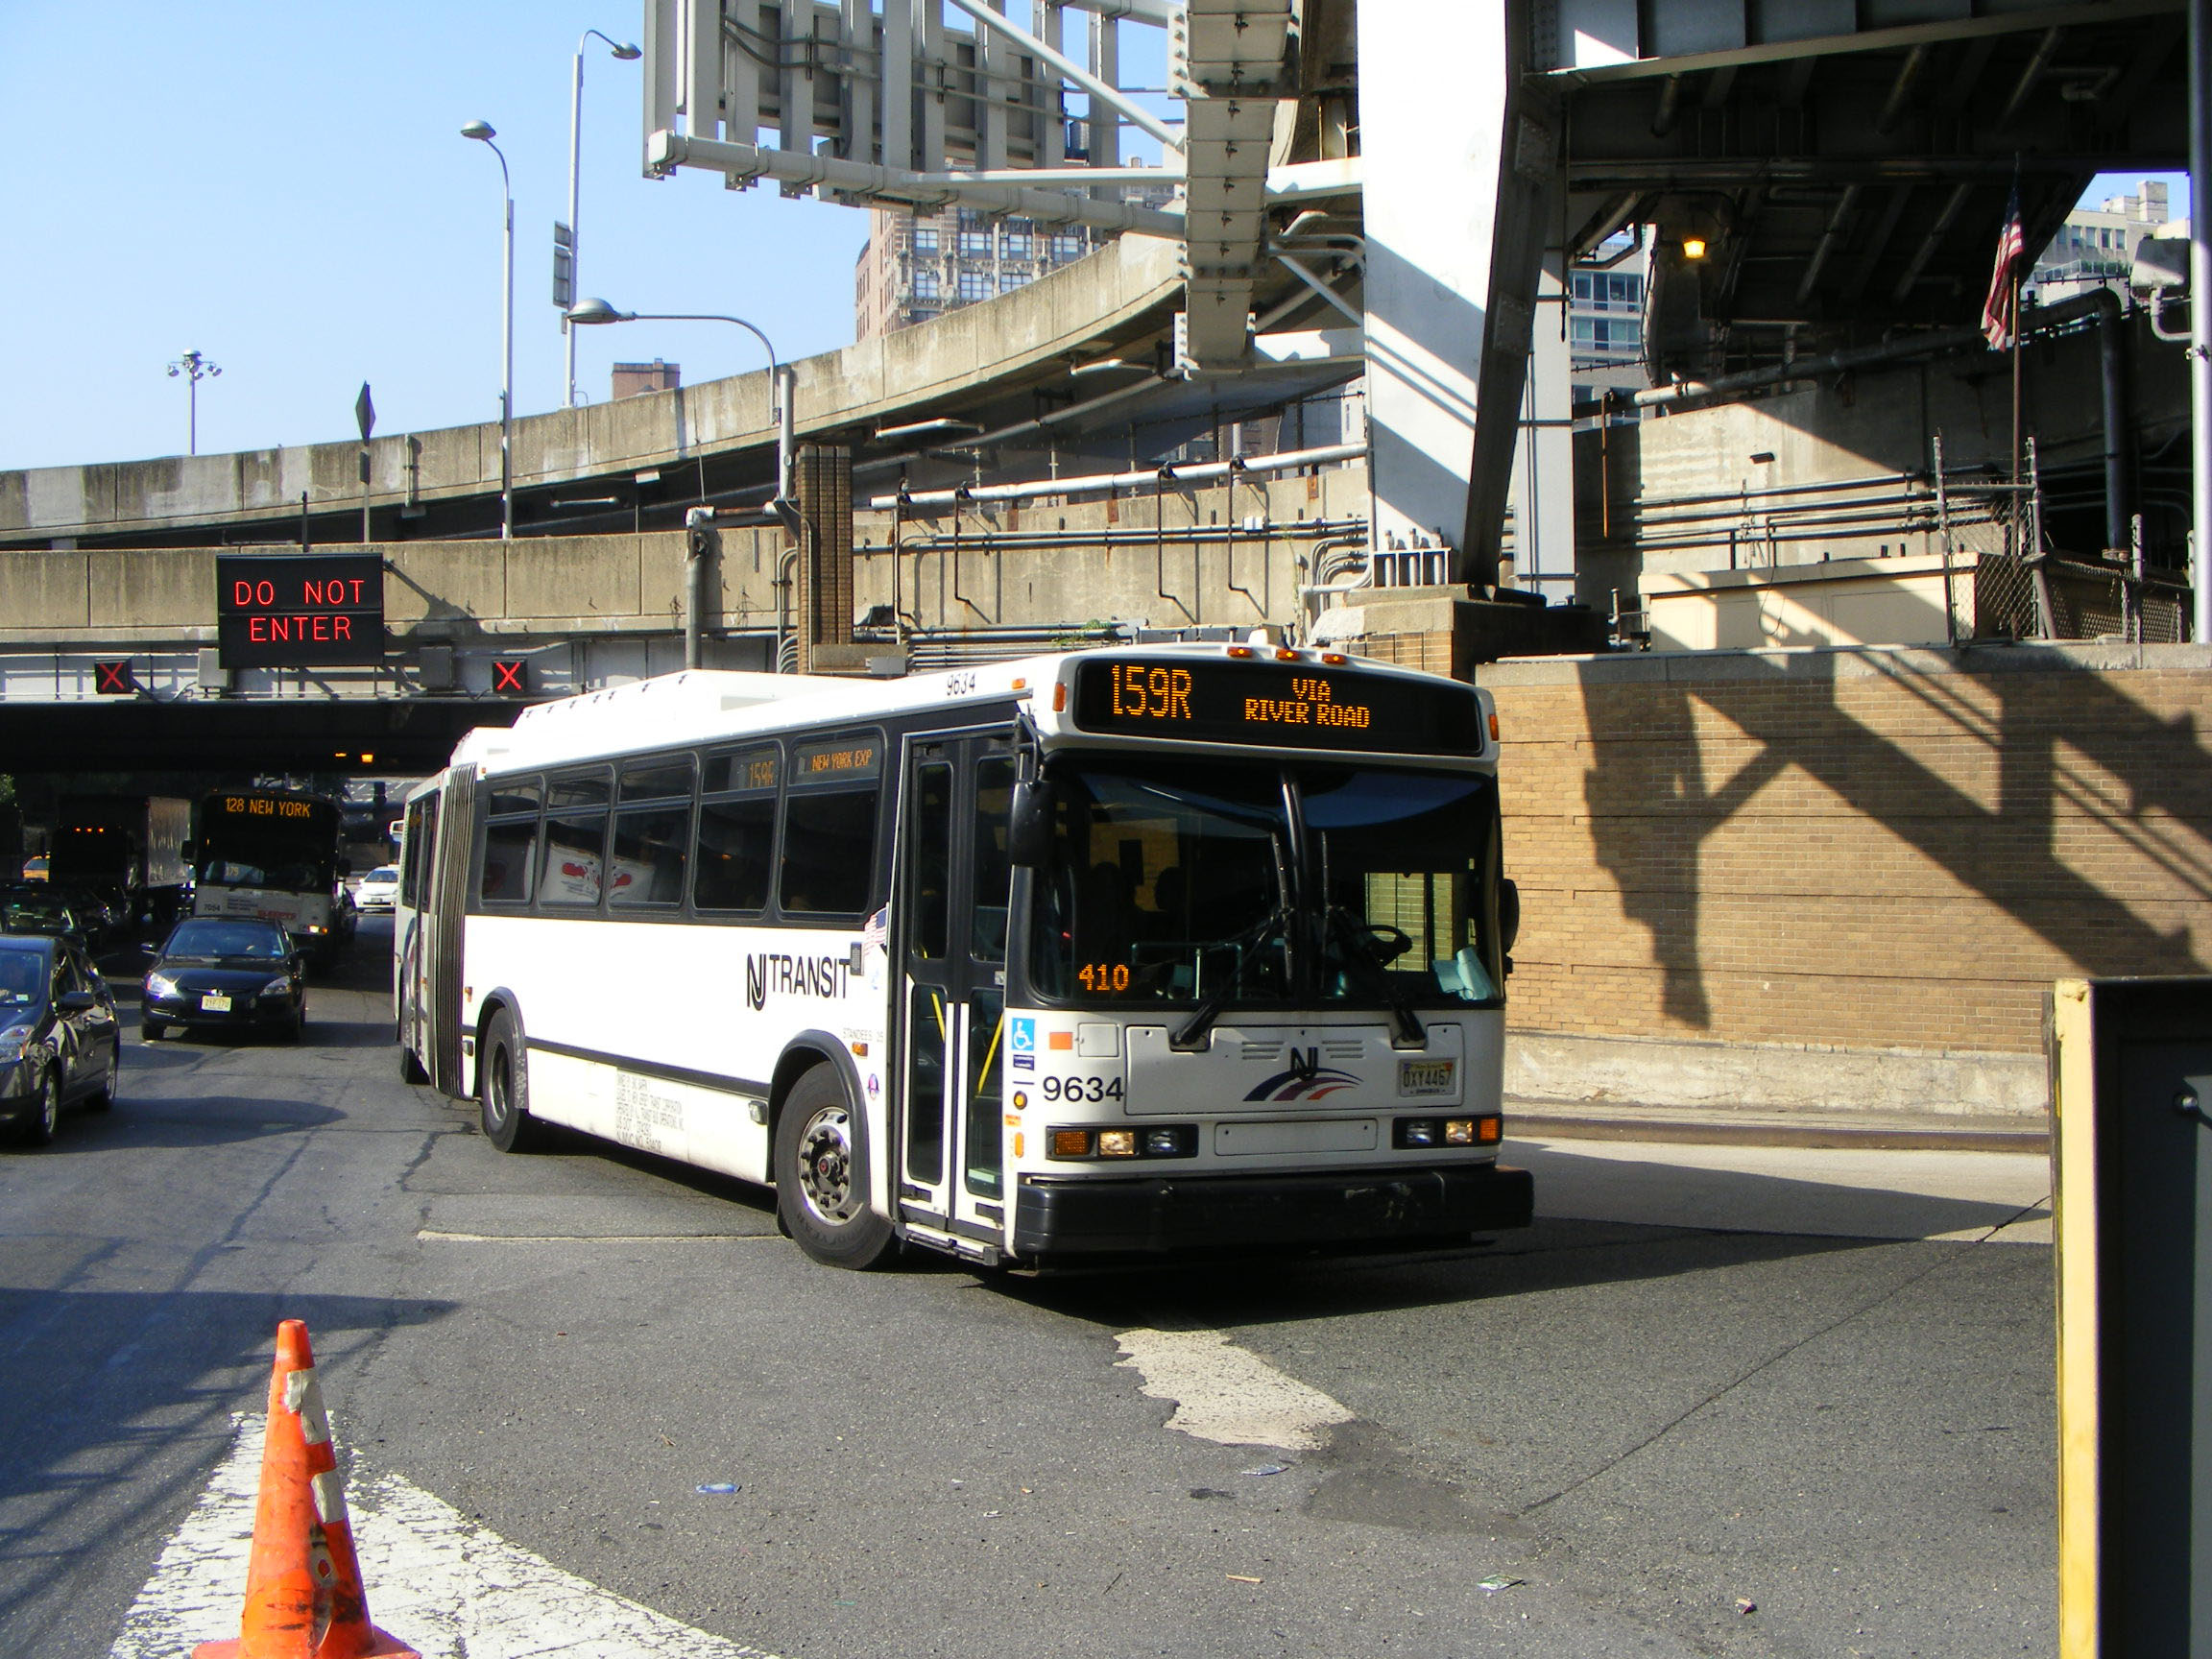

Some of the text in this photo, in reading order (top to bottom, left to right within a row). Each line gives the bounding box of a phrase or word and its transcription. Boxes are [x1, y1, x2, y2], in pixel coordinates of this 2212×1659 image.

[234, 580, 365, 606] DO NOT
[249, 616, 352, 642] ENTER
[946, 672, 976, 696] 9634
[1112, 664, 1192, 719] 159R
[1292, 678, 1332, 702] VIA
[1244, 698, 1371, 728] RIVER ROAD
[812, 748, 873, 772] NEW YORK EXP
[226, 798, 312, 818] 128 NEW YORK
[746, 952, 852, 1012] NJ TRANSIT
[1078, 964, 1130, 991] 410
[1290, 1046, 1319, 1082] NJ
[1042, 1075, 1124, 1103] 9634
